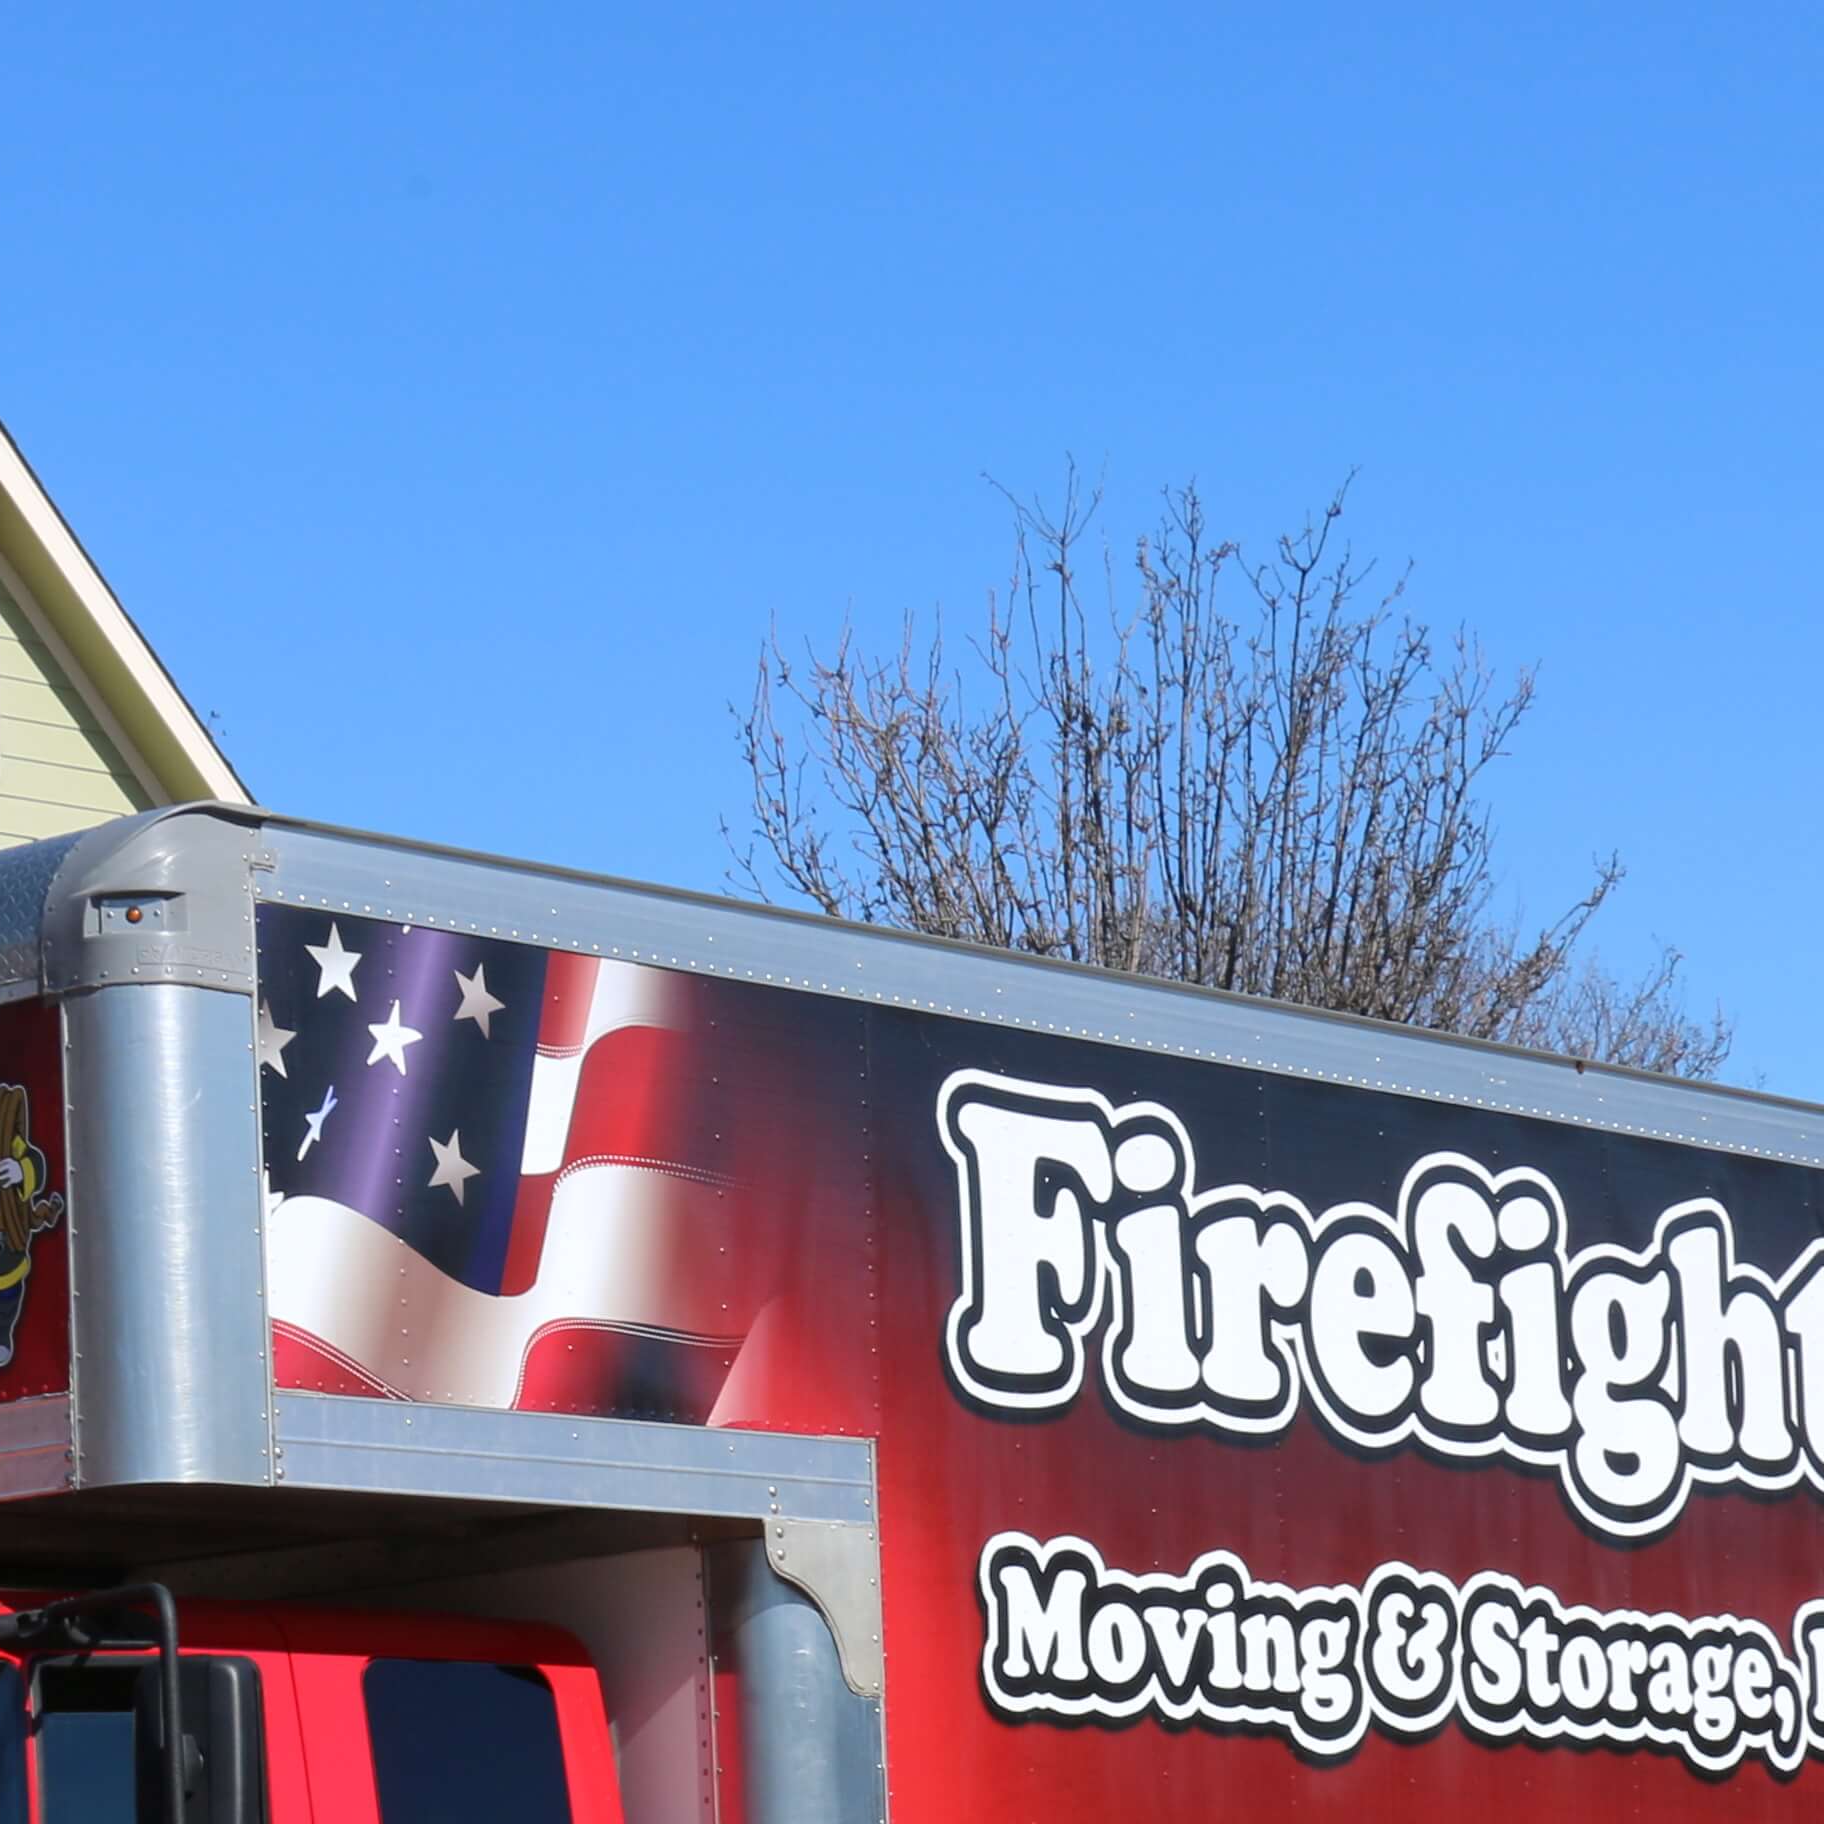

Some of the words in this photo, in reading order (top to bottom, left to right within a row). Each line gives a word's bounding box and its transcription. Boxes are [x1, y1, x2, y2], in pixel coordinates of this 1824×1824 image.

[998, 1565, 1352, 1721] Moving
[1375, 1588, 1449, 1700] &
[1469, 1597, 1798, 1738] Storage,
